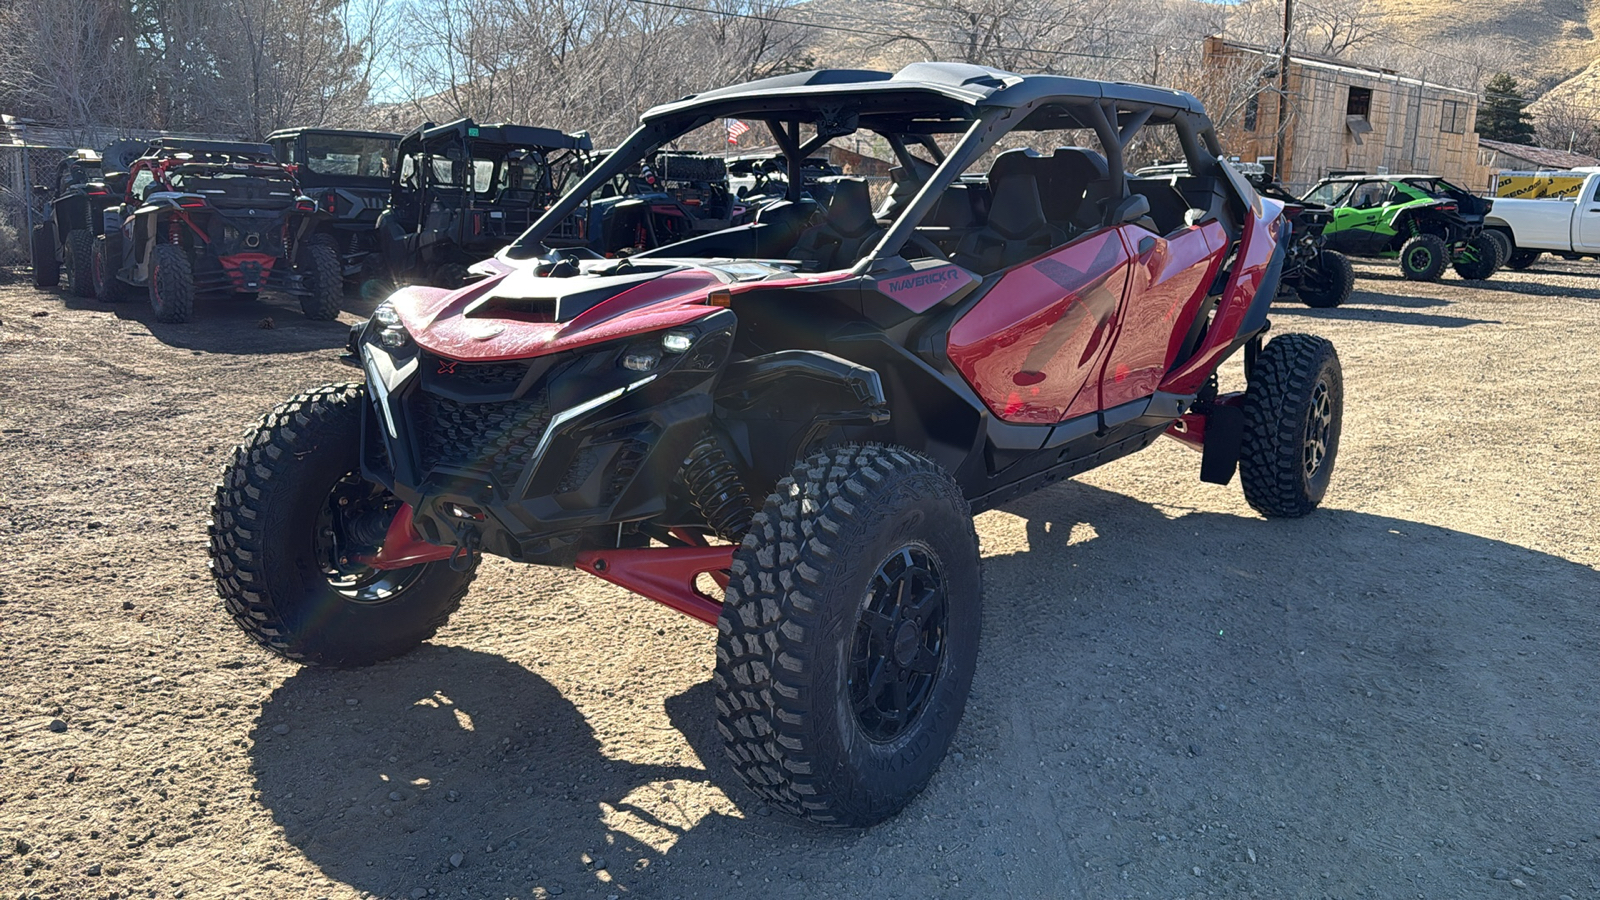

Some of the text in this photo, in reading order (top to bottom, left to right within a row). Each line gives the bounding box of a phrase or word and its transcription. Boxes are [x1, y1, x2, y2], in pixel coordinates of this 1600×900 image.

[889, 268, 959, 293] MAVERICK R
[900, 678, 959, 769] TENACITY
